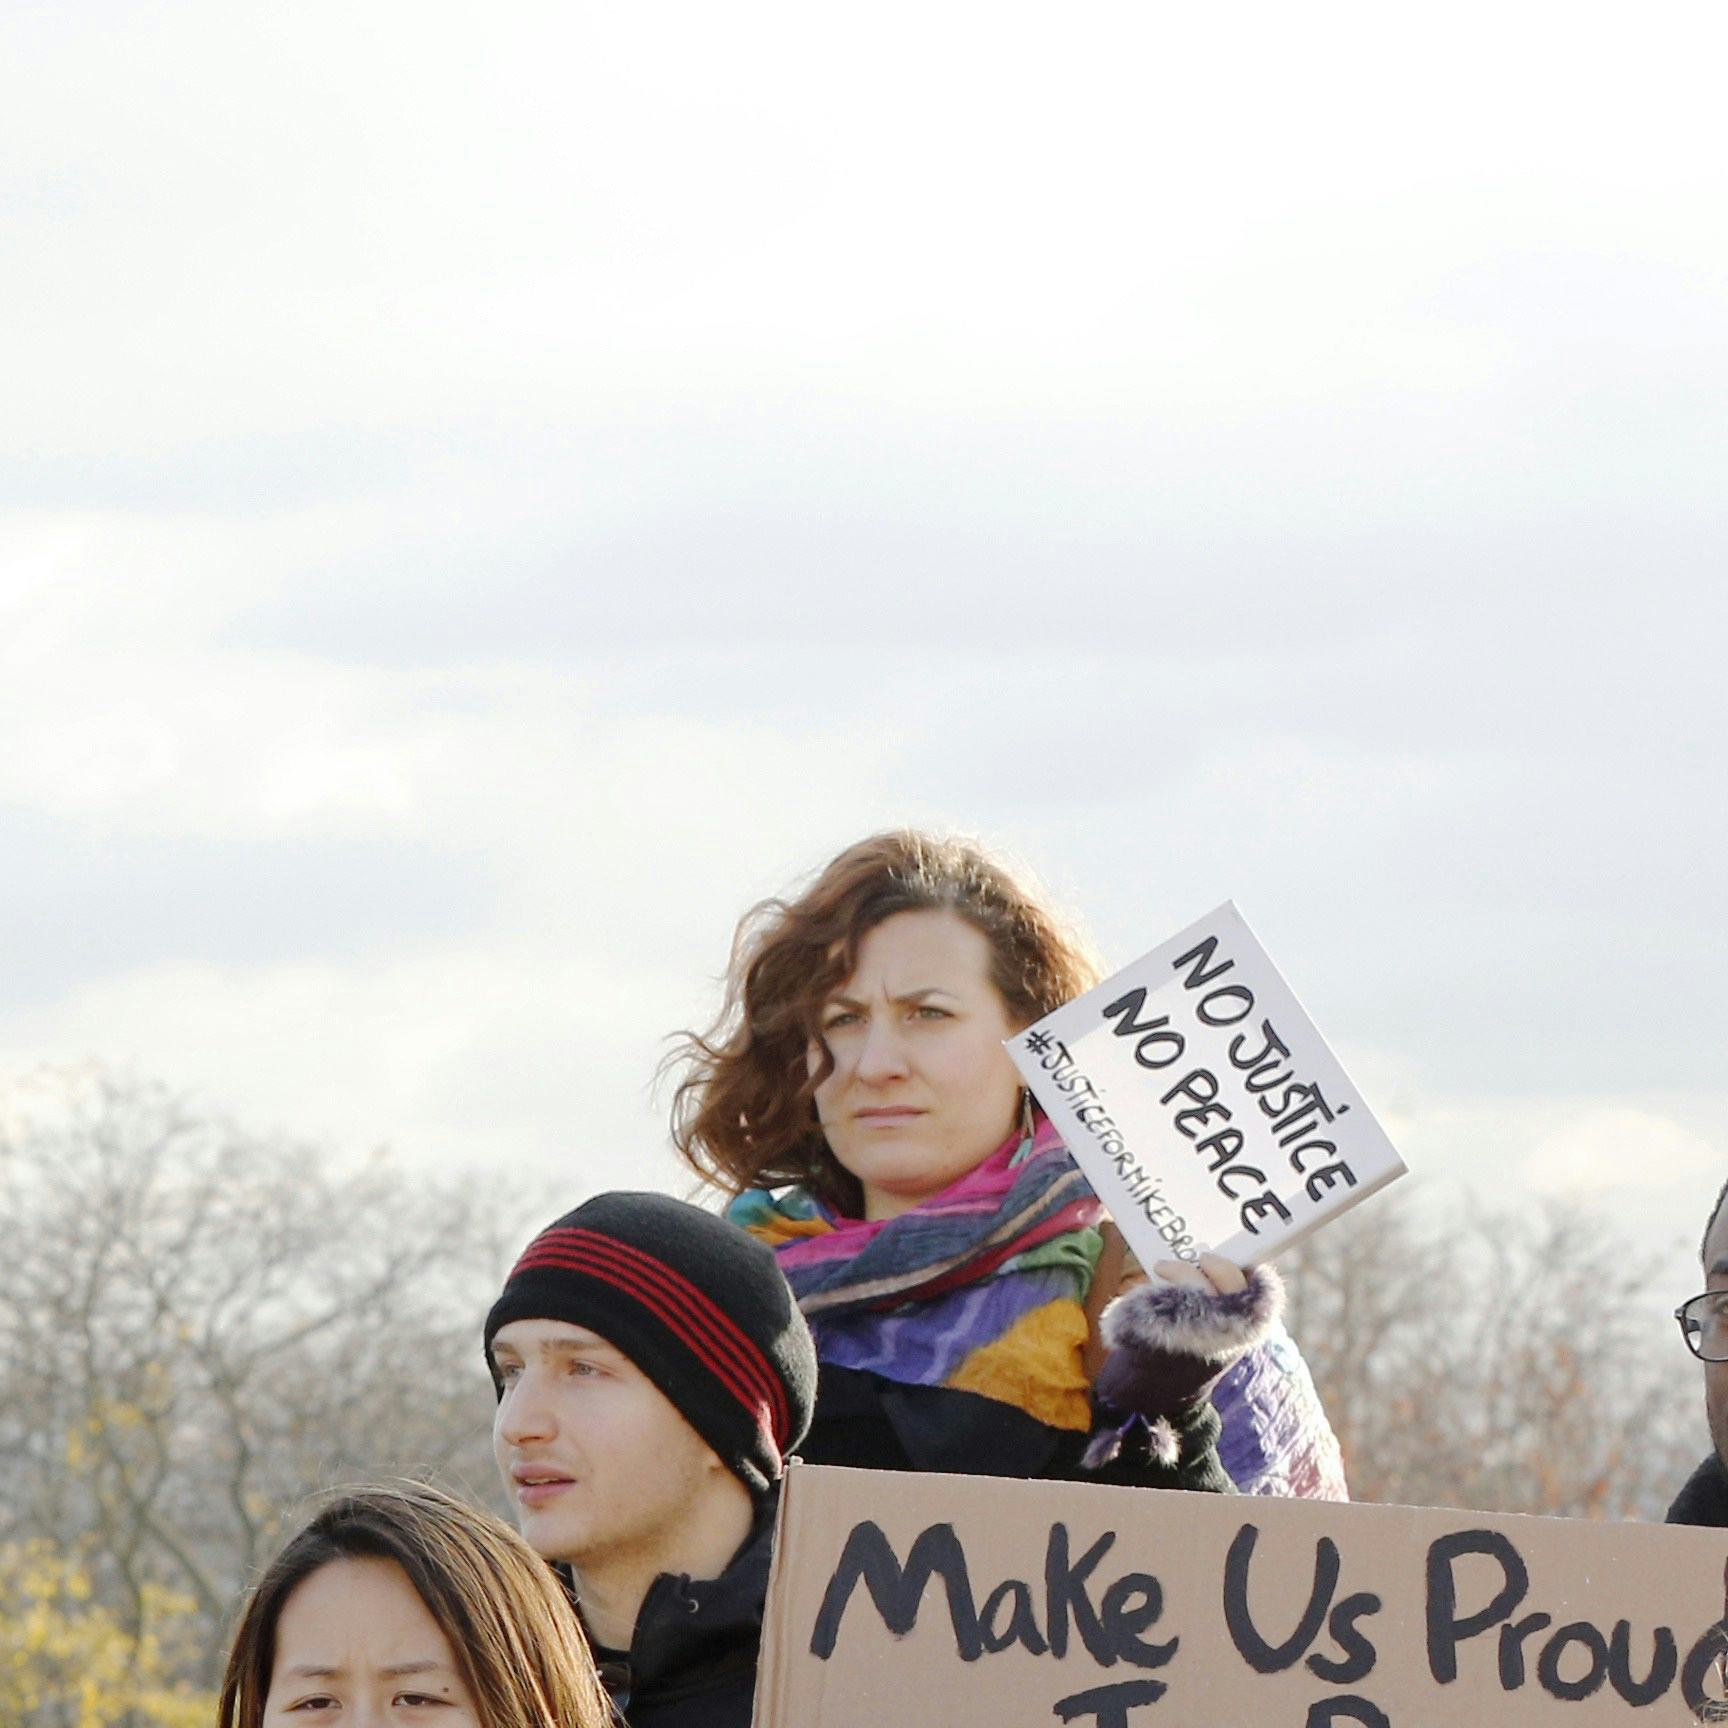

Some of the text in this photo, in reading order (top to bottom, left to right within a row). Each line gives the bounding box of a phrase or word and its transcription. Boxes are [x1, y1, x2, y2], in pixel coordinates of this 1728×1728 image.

[1024, 1029, 1200, 1264] #JUSTICEFORMIKEBRO
[1102, 986, 1293, 1236] NO PEACE
[1172, 935, 1359, 1203] NO JUSTICE
[1224, 1522, 1381, 1685] Us
